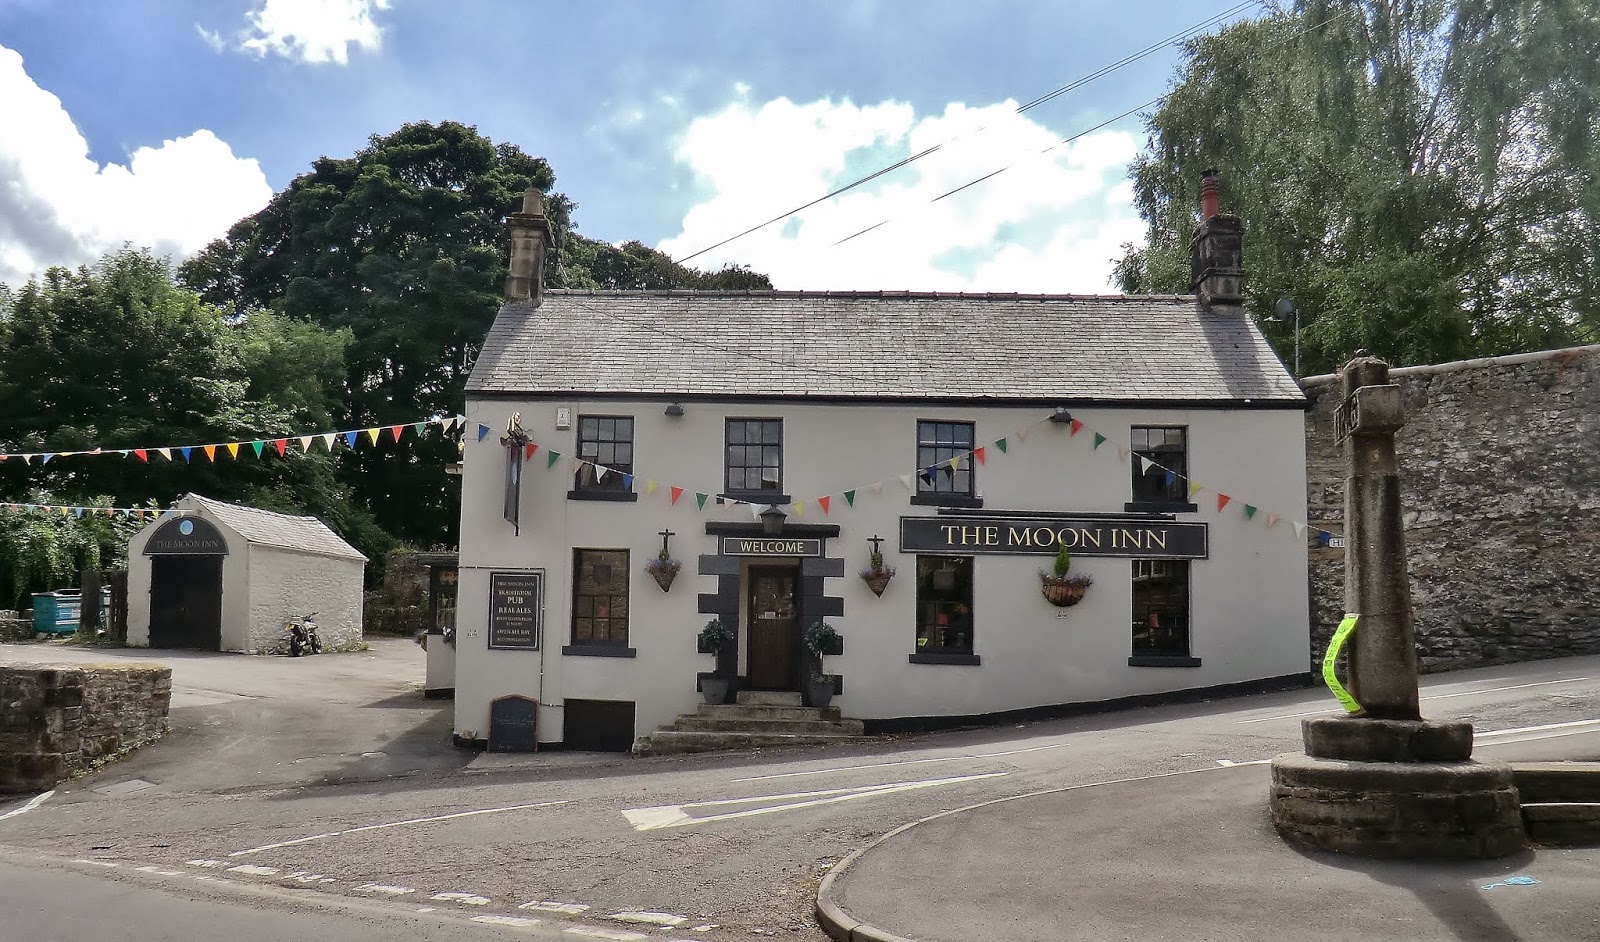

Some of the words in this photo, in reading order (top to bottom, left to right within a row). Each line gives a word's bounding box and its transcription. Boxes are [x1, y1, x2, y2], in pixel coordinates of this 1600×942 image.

[941, 525, 999, 546] THE
[1007, 526, 1102, 549] MOON
[1111, 528, 1168, 550] INN
[156, 540, 172, 548] THE
[173, 540, 201, 548] MOON
[740, 541, 804, 553] WELCOME
[507, 596, 524, 604] PUB
